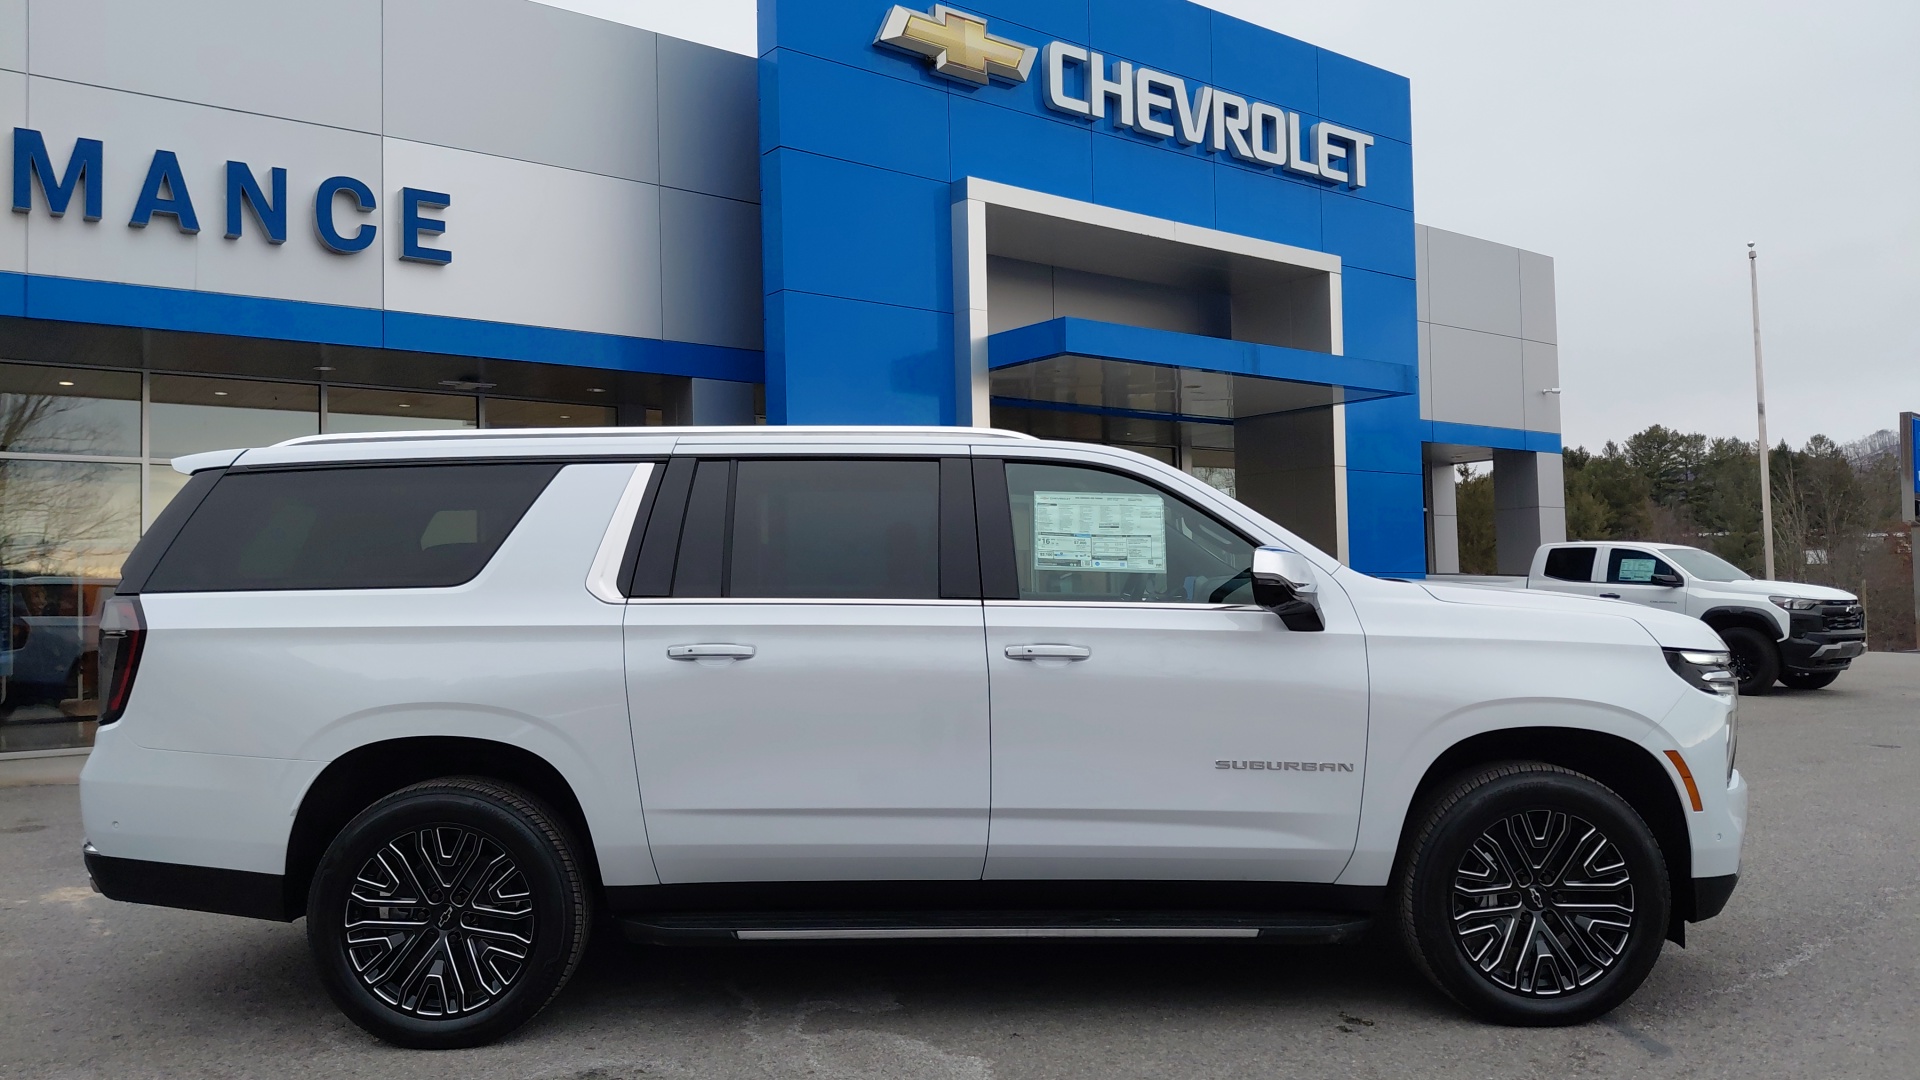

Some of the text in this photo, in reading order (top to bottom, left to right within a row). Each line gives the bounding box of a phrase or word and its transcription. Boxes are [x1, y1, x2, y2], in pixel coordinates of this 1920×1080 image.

[1042, 41, 1374, 188] CHEVROLET
[12, 127, 452, 265] MANCE
[1214, 759, 1354, 772] SUBURBAN
